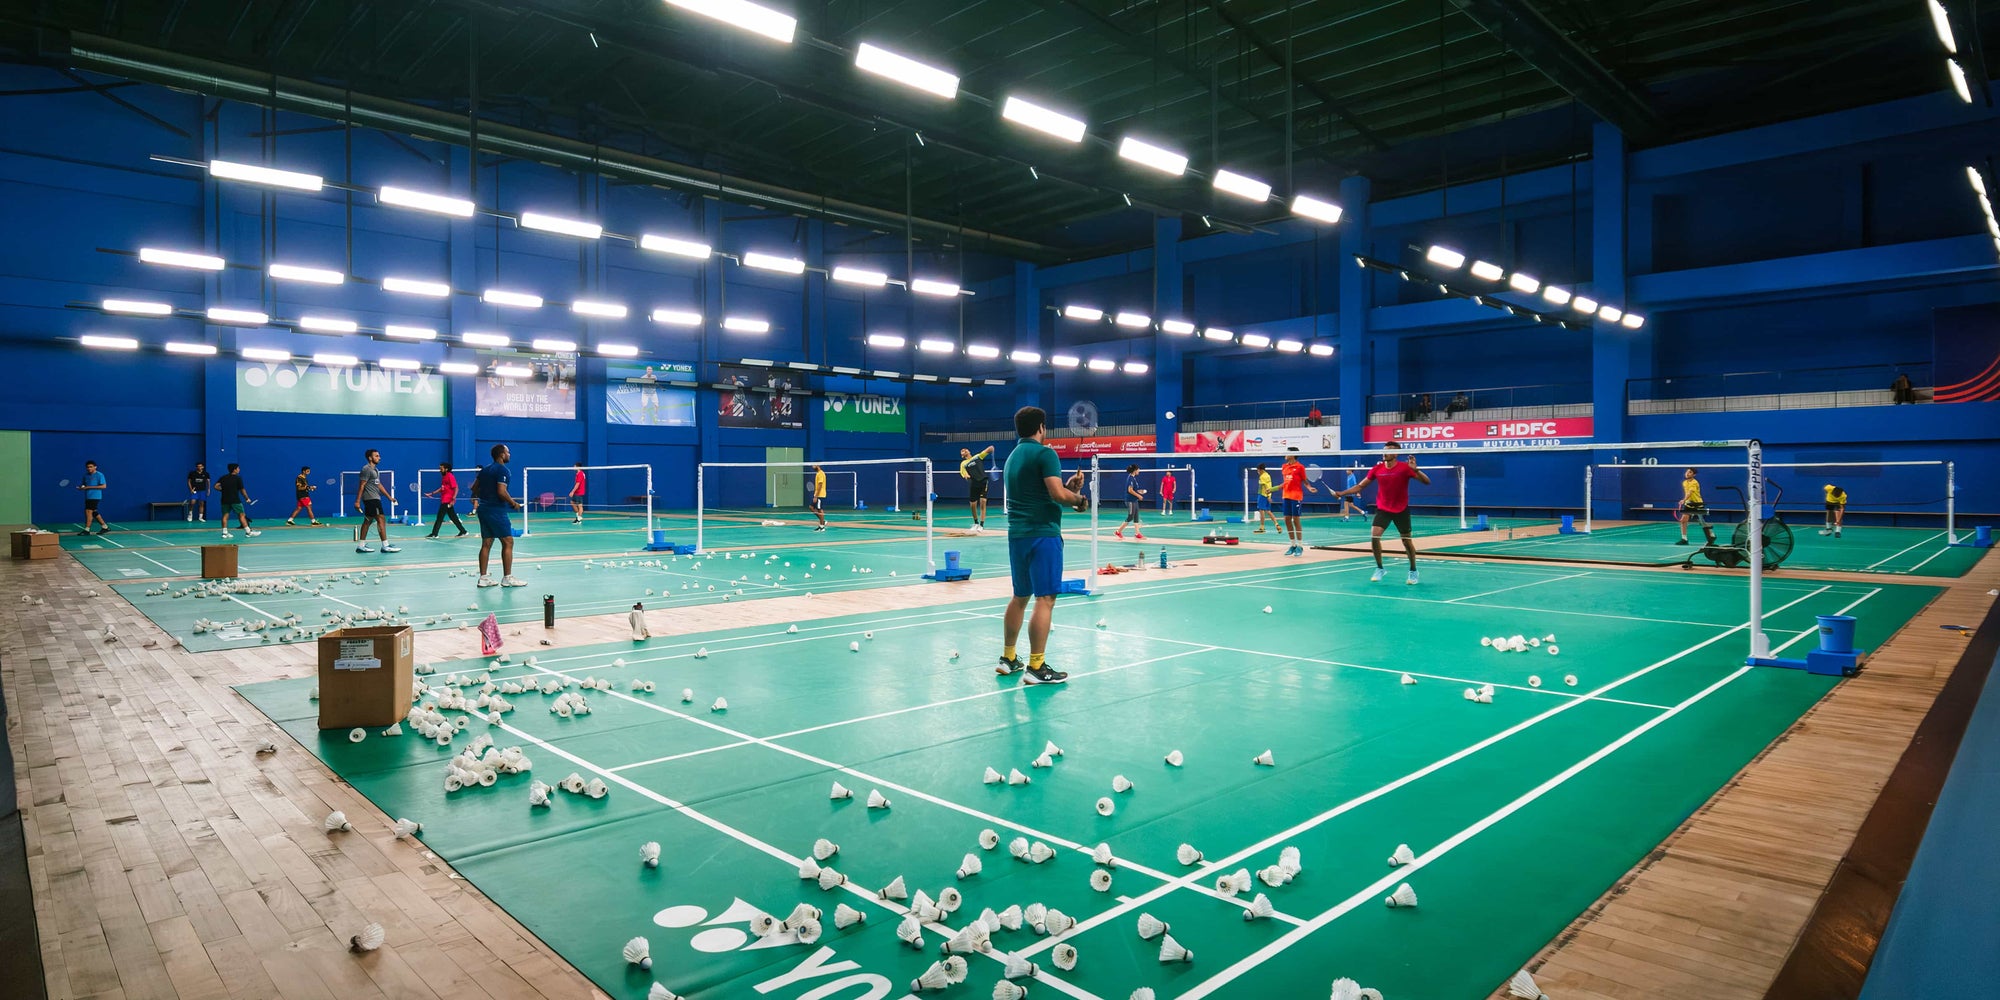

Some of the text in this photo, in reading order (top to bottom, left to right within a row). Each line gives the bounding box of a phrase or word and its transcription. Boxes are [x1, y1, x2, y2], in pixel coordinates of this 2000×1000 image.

[672, 364, 692, 372] YONEX
[326, 362, 434, 394] YONEX
[507, 393, 548, 403] USED BY THE
[503, 402, 551, 412] WORLD'S BEST
[853, 395, 900, 415] YONEX
[1406, 426, 1455, 439] HDFC
[1501, 422, 1557, 436] HDFC
[1483, 438, 1561, 448] MUTUAL FUND
[1641, 457, 1658, 465] 10
[1751, 453, 1761, 484] PPBA
